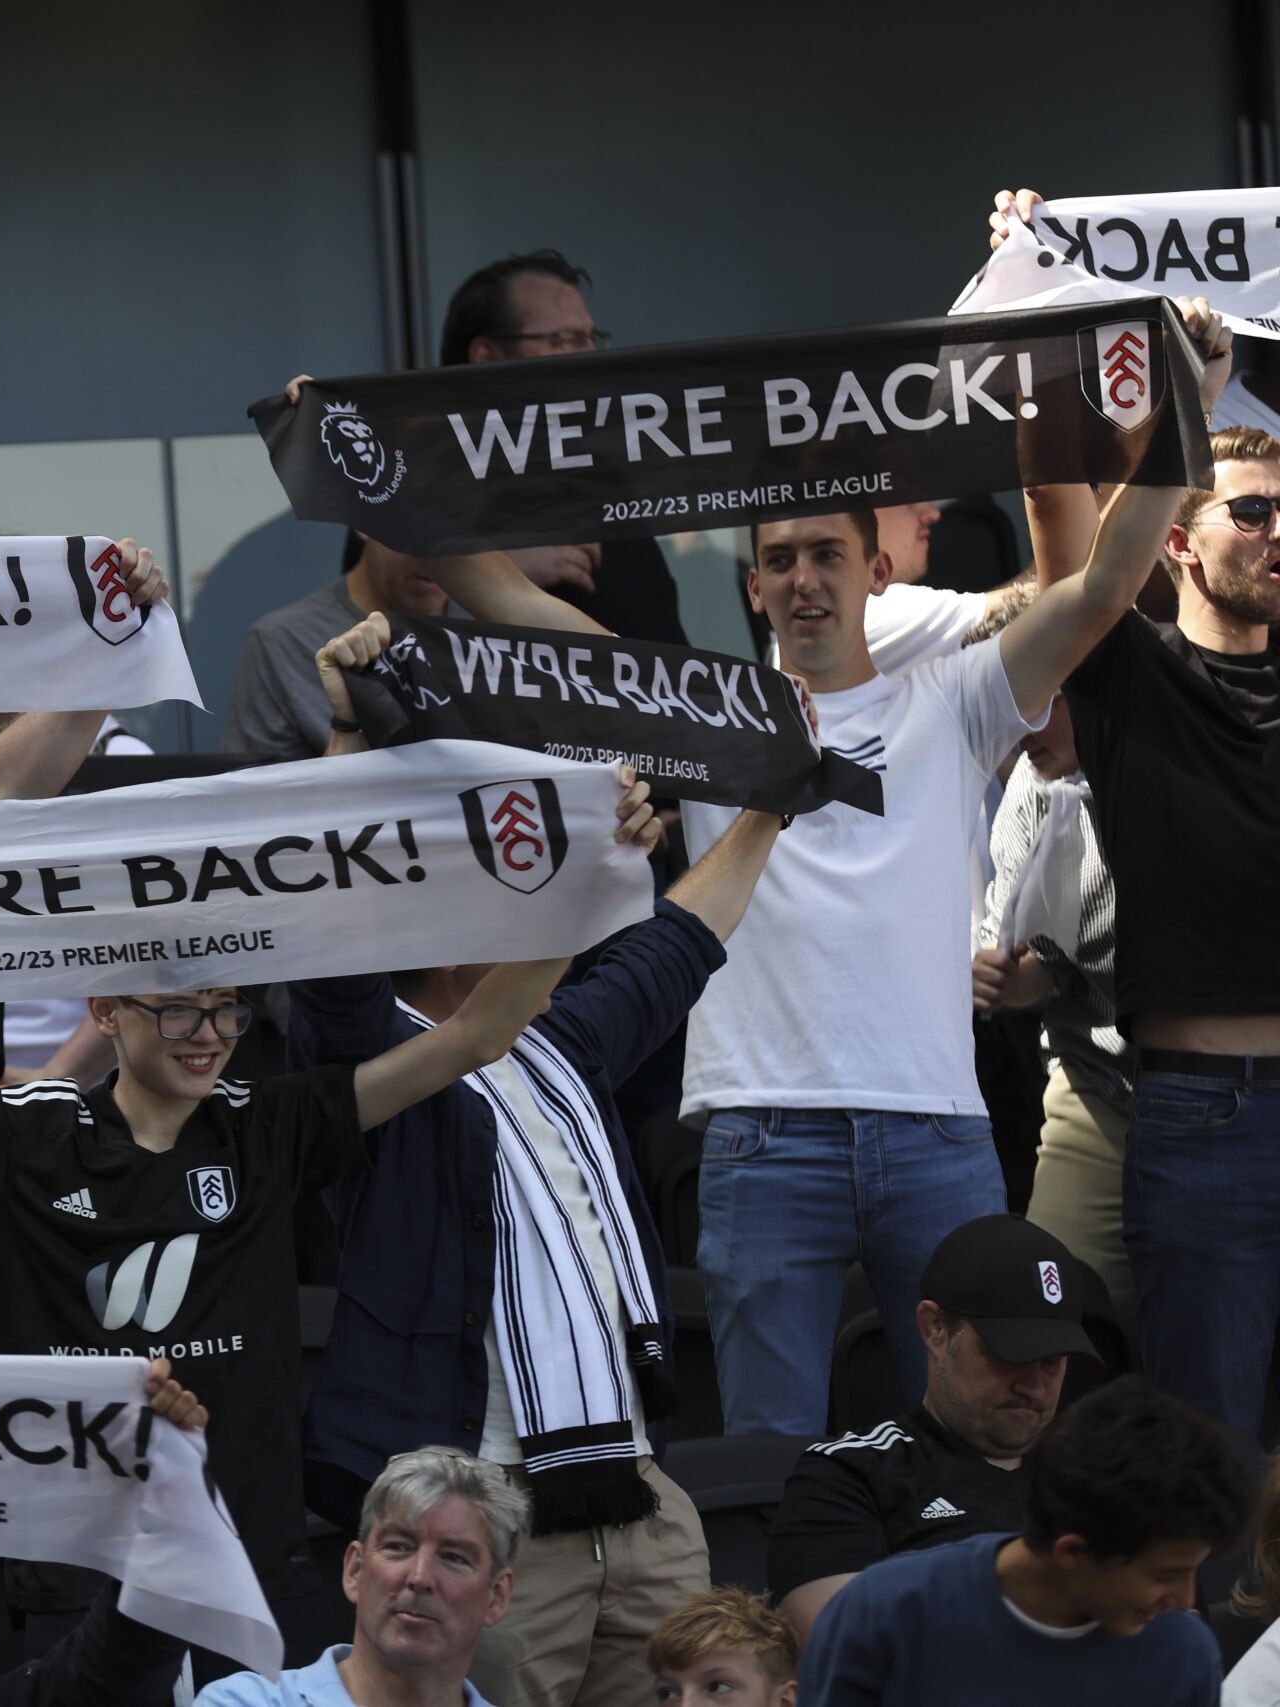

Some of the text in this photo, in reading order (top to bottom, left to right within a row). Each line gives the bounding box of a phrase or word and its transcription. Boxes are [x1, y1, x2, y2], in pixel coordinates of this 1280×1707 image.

[1103, 331, 1146, 409] FFC
[447, 352, 1039, 480] WE'RE BACK!
[358, 449, 404, 505] Premier League
[602, 471, 894, 522] 2022/23 PREMIER LEAGUE
[611, 651, 778, 735] BACK!
[658, 756, 710, 782] LEAGUE
[490, 790, 545, 872] FFC
[120, 819, 427, 908] BACK!
[62, 935, 170, 968] PREMIER
[175, 929, 276, 959] LEAGUE
[52, 1199, 98, 1220] adidas
[201, 1174, 224, 1210] FFC
[1042, 1265, 1060, 1297] FFC
[148, 1335, 244, 1361] MOBILE
[920, 1509, 966, 1520] adidas
